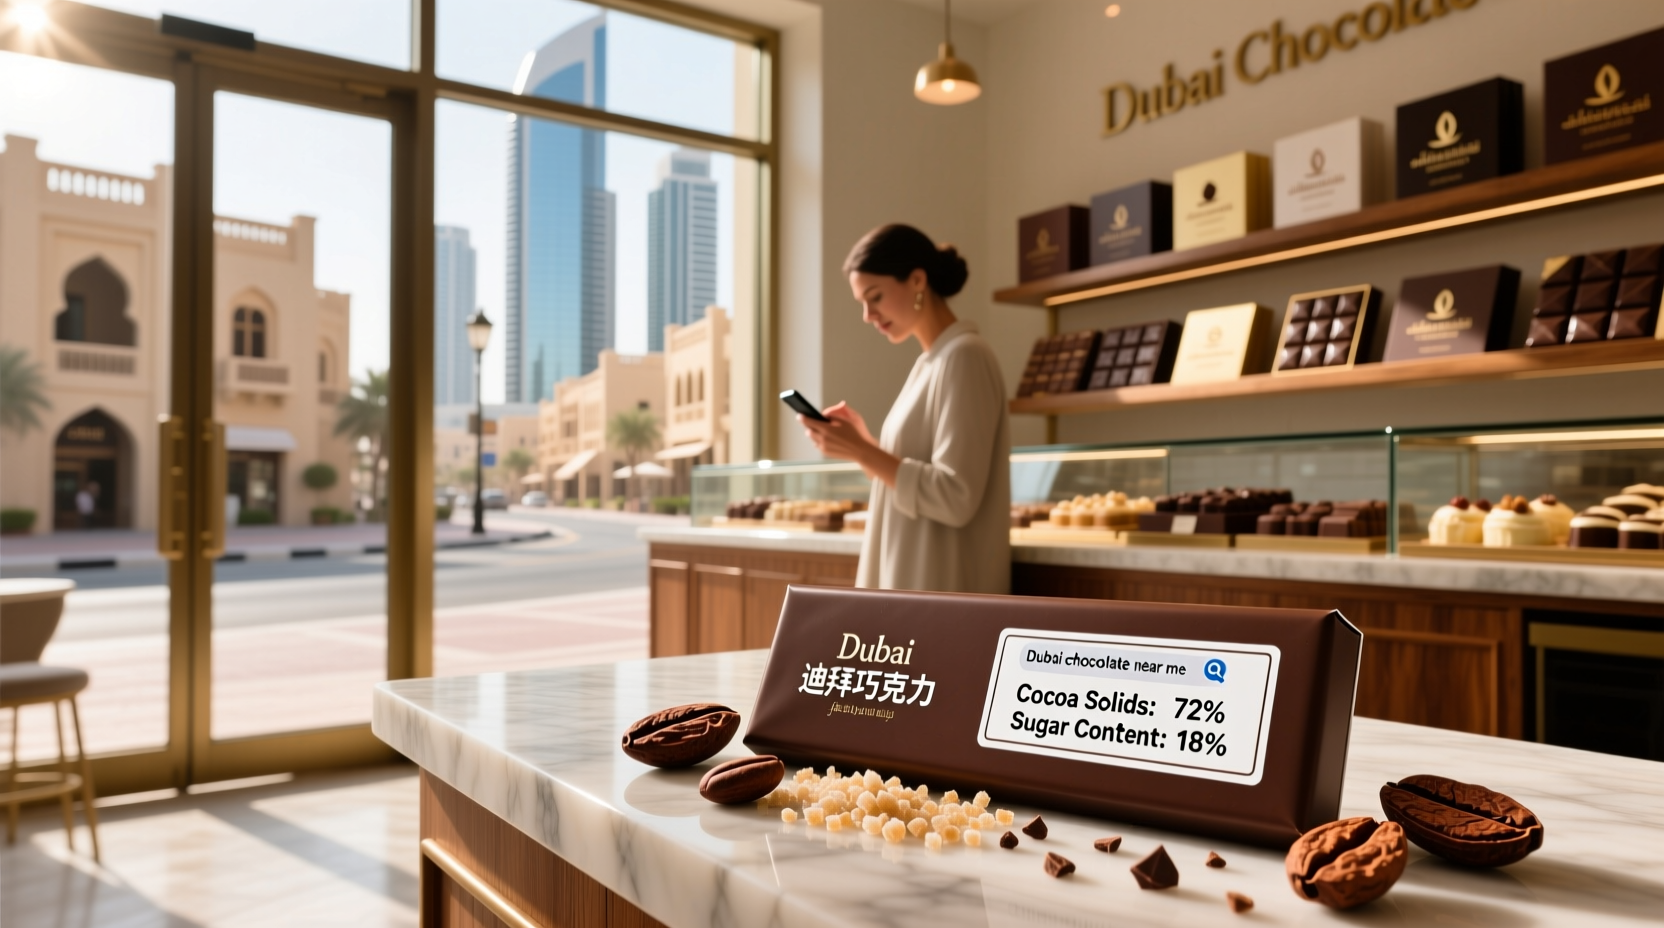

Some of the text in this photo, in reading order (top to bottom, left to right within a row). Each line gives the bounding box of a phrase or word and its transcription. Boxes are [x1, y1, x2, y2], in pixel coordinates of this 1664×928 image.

[1101, 50, 1225, 137] Dubai
[836, 633, 915, 665] Dubai
[1026, 649, 1187, 676] Dubai chocolate near me
[798, 662, 936, 707] 迪拜巧克力
[1016, 683, 1226, 724] Cocoa Solids: 72%
[1010, 711, 1227, 757] Sugar Content: 18%
